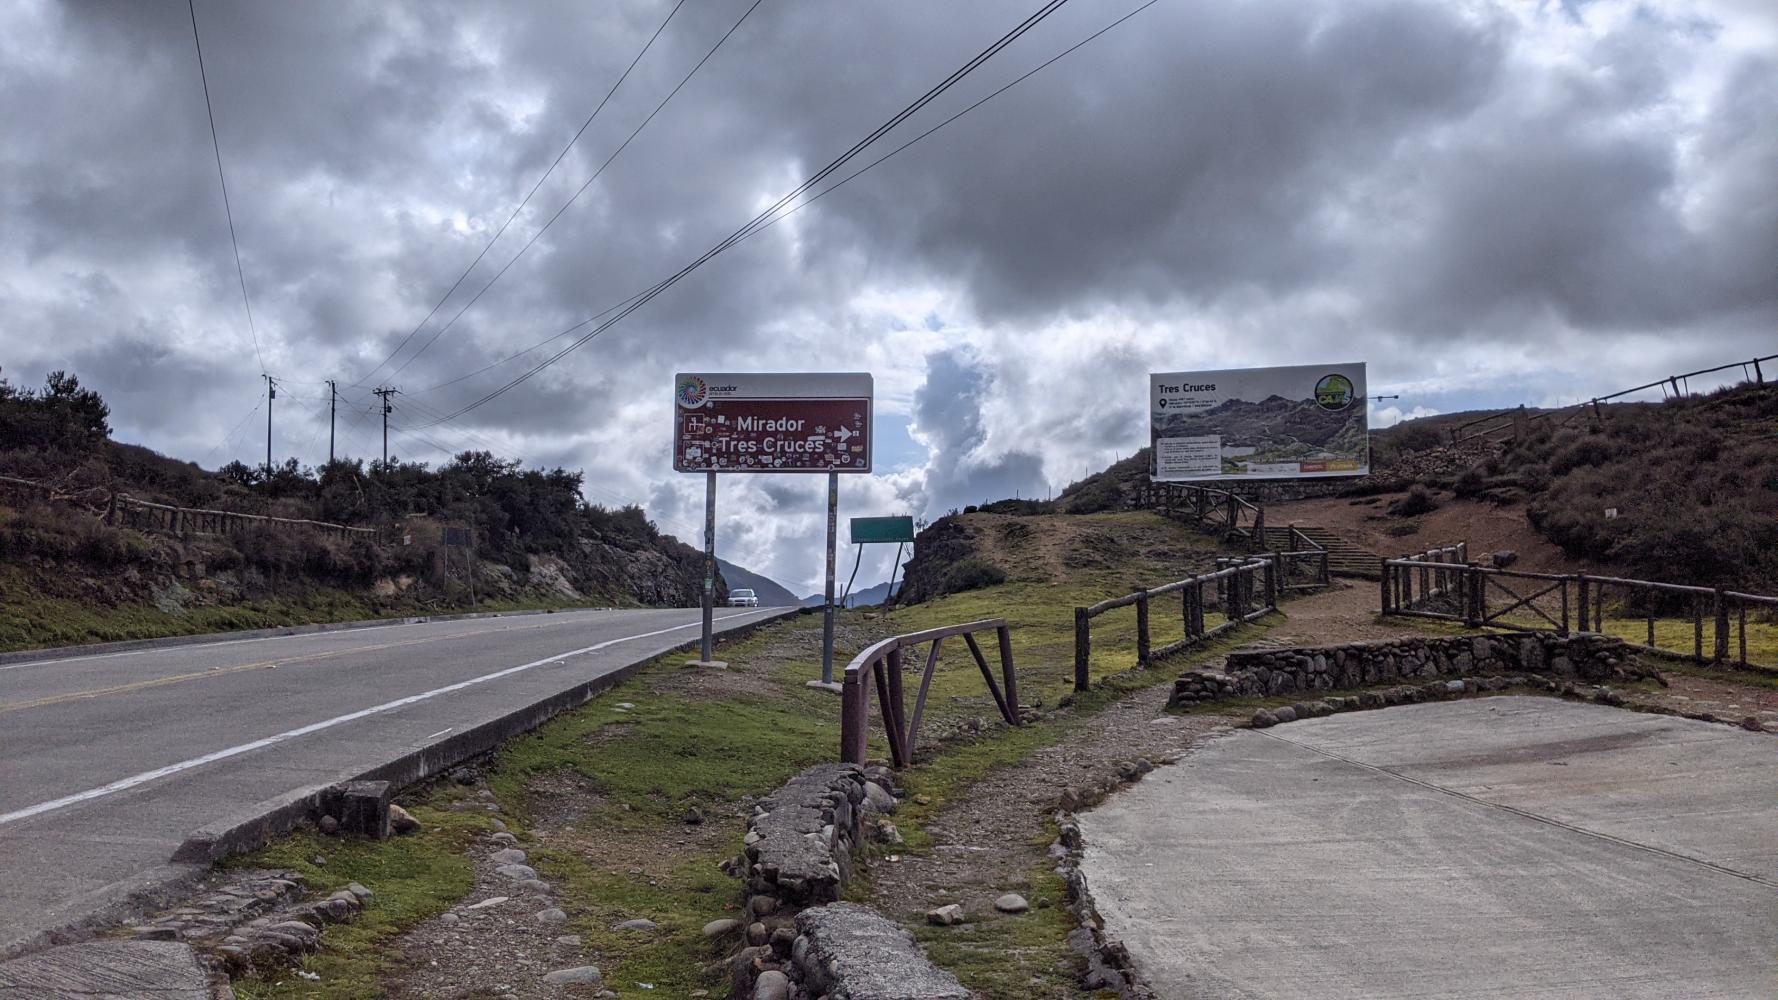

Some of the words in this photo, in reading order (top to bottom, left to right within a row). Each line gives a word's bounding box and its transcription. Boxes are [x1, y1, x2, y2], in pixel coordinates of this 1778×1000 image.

[1158, 384, 1180, 394] Tres
[1183, 383, 1216, 392] Cruces
[737, 416, 805, 432] Mirador
[719, 437, 757, 452] Tres
[763, 437, 824, 453] Cruces
